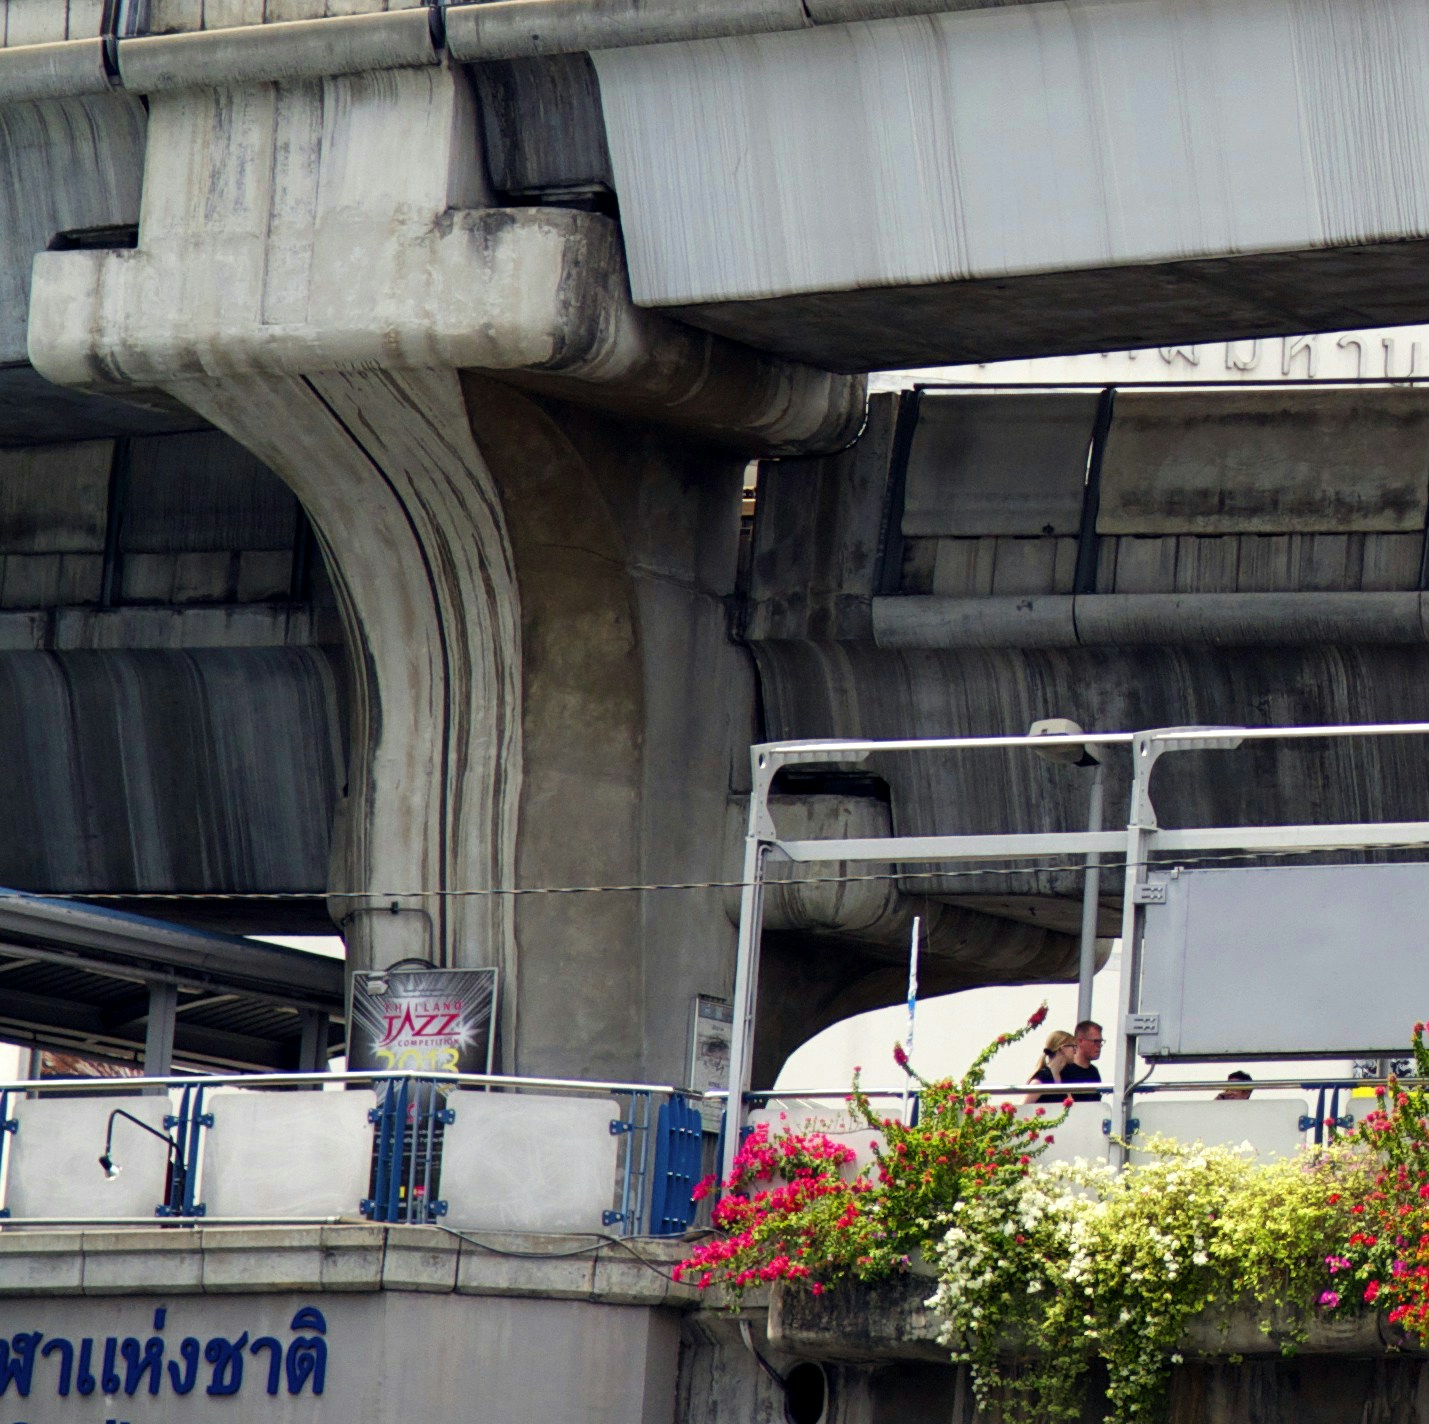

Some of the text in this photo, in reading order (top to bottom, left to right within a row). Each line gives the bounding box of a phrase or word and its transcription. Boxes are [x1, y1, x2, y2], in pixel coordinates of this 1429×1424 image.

[384, 1000, 463, 1013] THAILAND
[379, 1002, 461, 1047] JAZZ
[398, 1038, 459, 1048] COMPETITION
[376, 1048, 459, 1073] 2013
